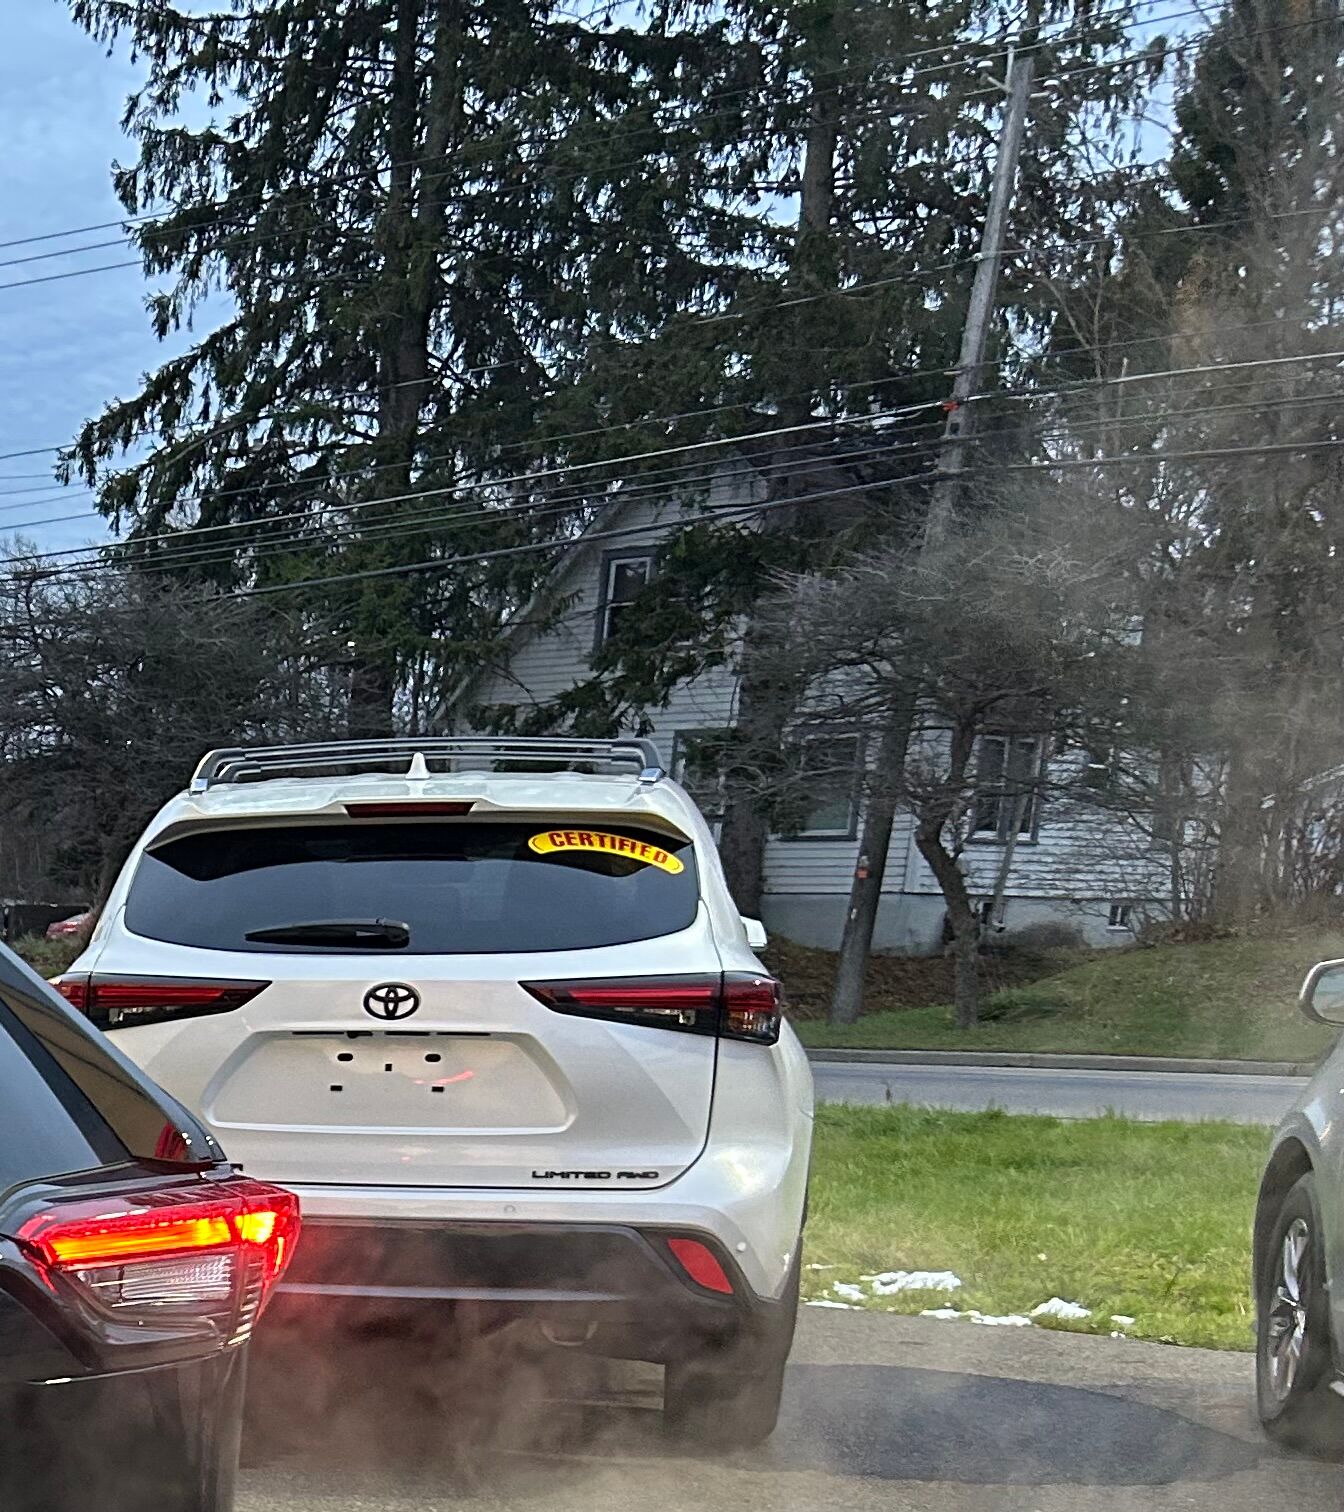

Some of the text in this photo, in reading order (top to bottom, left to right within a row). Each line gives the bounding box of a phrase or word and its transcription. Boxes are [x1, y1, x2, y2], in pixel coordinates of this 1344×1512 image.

[548, 831, 669, 864] CERTIFIED
[531, 1170, 660, 1180] LIMITED AWD
